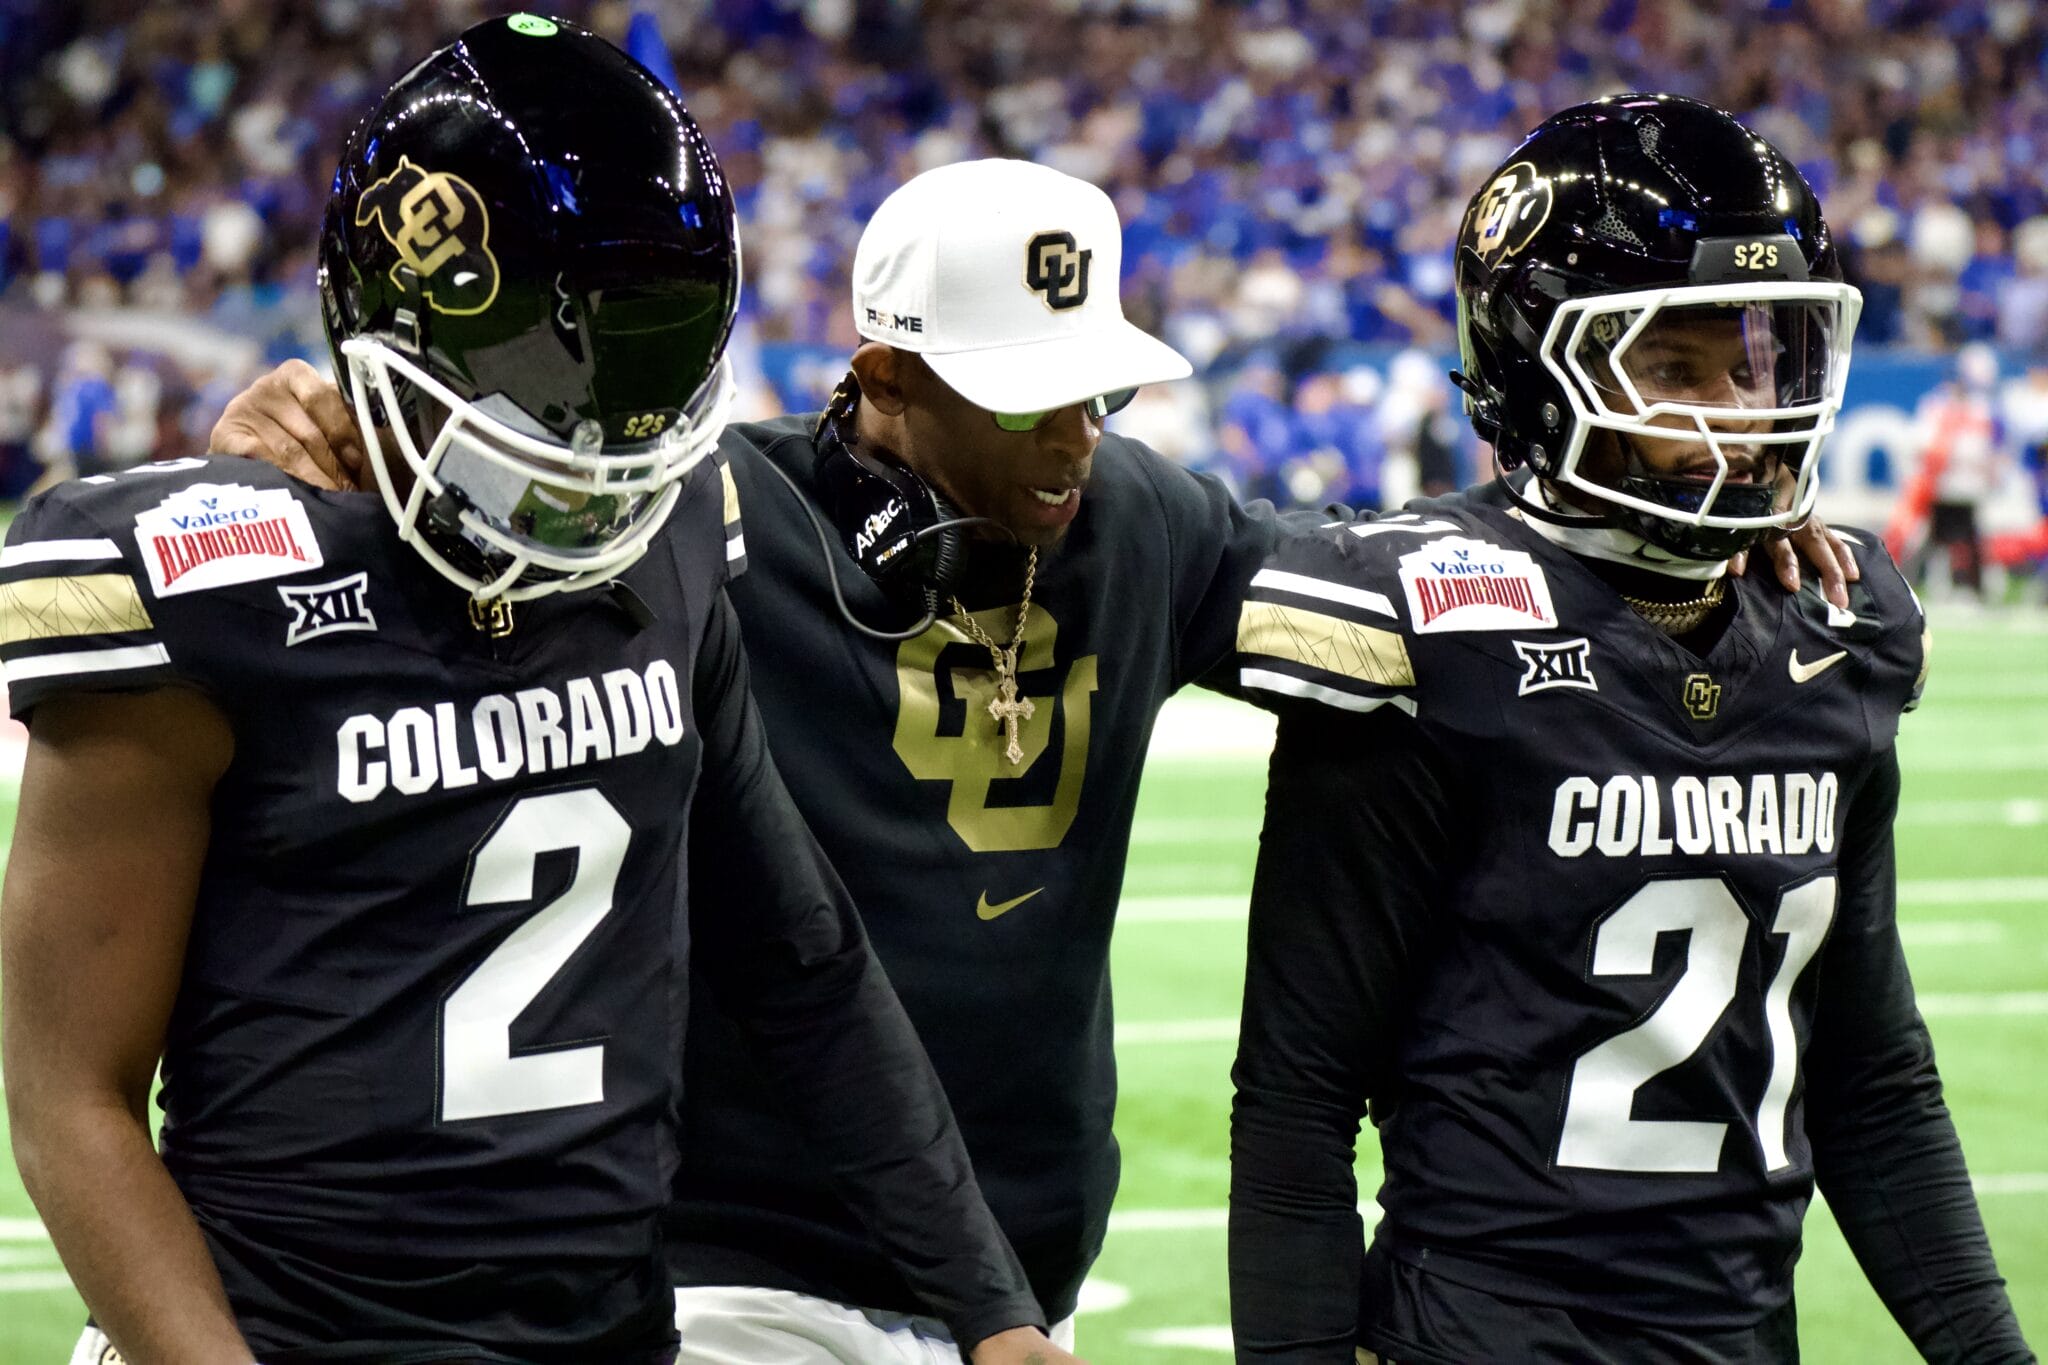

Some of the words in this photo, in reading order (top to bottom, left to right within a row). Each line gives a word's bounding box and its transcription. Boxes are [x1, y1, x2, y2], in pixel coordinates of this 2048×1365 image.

[1023, 229, 1092, 312] CU
[171, 506, 259, 530] Valero
[284, 578, 371, 641] XII
[1430, 561, 1504, 575] Valero
[1519, 644, 1593, 689] XII
[337, 659, 684, 803] COLORADO
[892, 602, 1099, 853] CU
[1547, 771, 1839, 857] COLORADO
[442, 787, 633, 1122] 2
[1556, 876, 1837, 1173] 21
